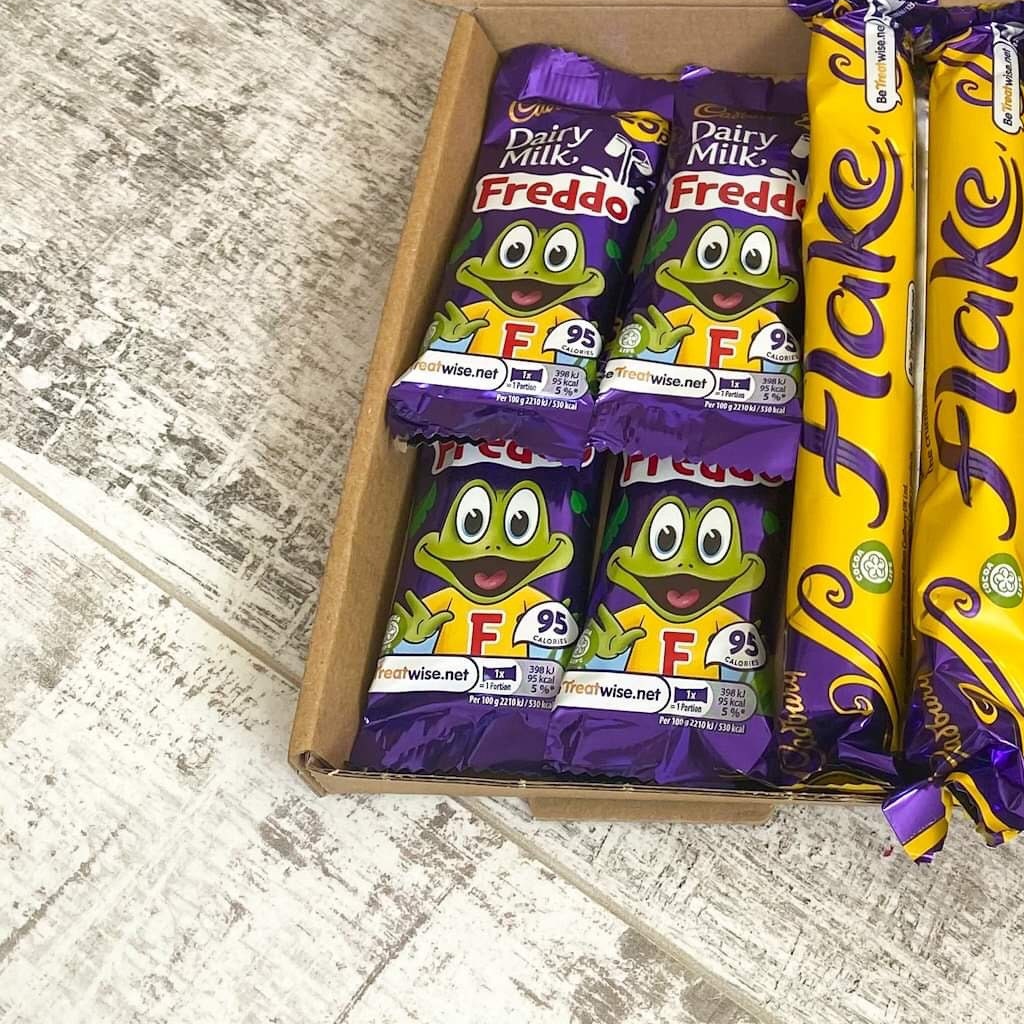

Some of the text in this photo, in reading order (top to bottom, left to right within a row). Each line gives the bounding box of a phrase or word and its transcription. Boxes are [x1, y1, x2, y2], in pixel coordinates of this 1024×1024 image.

[875, 25, 887, 104] Be Treatwise.ne
[1003, 112, 1013, 126] Be
[505, 124, 593, 151] Dairy
[691, 120, 779, 151] Dairy
[499, 143, 579, 169] Milk
[687, 142, 768, 168] Milk
[476, 175, 630, 222] Freddo
[502, 322, 536, 359] F
[567, 325, 595, 349] 95
[770, 328, 797, 352] 95
[800, 138, 904, 528] Flake
[561, 344, 594, 356] CALORIES
[709, 328, 738, 368] F
[930, 156, 1024, 541] Flake
[414, 360, 499, 380] reatwise.net
[555, 369, 570, 378] 398
[615, 366, 708, 389] Treatwise.net
[762, 377, 776, 385] 398
[562, 378, 579, 387] kcal
[770, 385, 786, 393] kcal
[852, 549, 865, 582] COCOA
[982, 562, 994, 594] COCOA
[537, 609, 567, 635] 95
[470, 612, 503, 656] F
[533, 635, 567, 645] CALORIES
[729, 630, 759, 656] 95
[662, 631, 695, 676] F
[725, 656, 760, 666] CALORIES
[527, 675, 555, 684] 95 kcal
[529, 665, 544, 674] 398
[469, 695, 481, 704] Per
[482, 696, 494, 705] 100
[531, 685, 537, 693] 5
[563, 679, 662, 701] Treatwise.net
[720, 688, 736, 697] 398
[718, 698, 746, 707] 95 kcal
[722, 708, 728, 716] 5
[659, 716, 671, 725] Per
